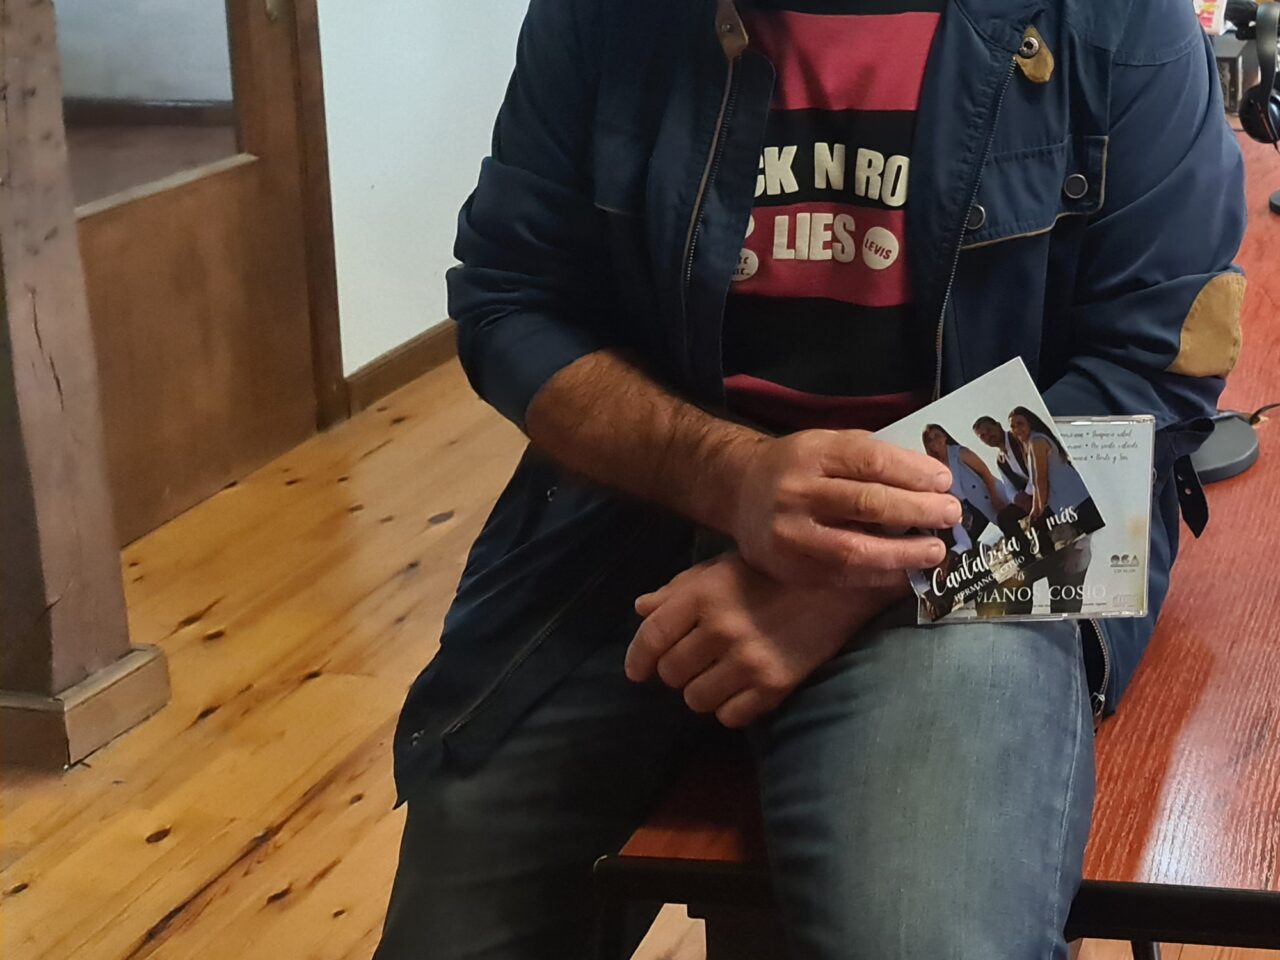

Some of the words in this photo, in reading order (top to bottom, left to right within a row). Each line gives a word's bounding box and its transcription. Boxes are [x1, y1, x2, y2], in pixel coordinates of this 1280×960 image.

[814, 142, 846, 190] N
[855, 147, 911, 207] RO
[773, 212, 856, 263] LIES
[864, 238, 893, 260] LEVIS
